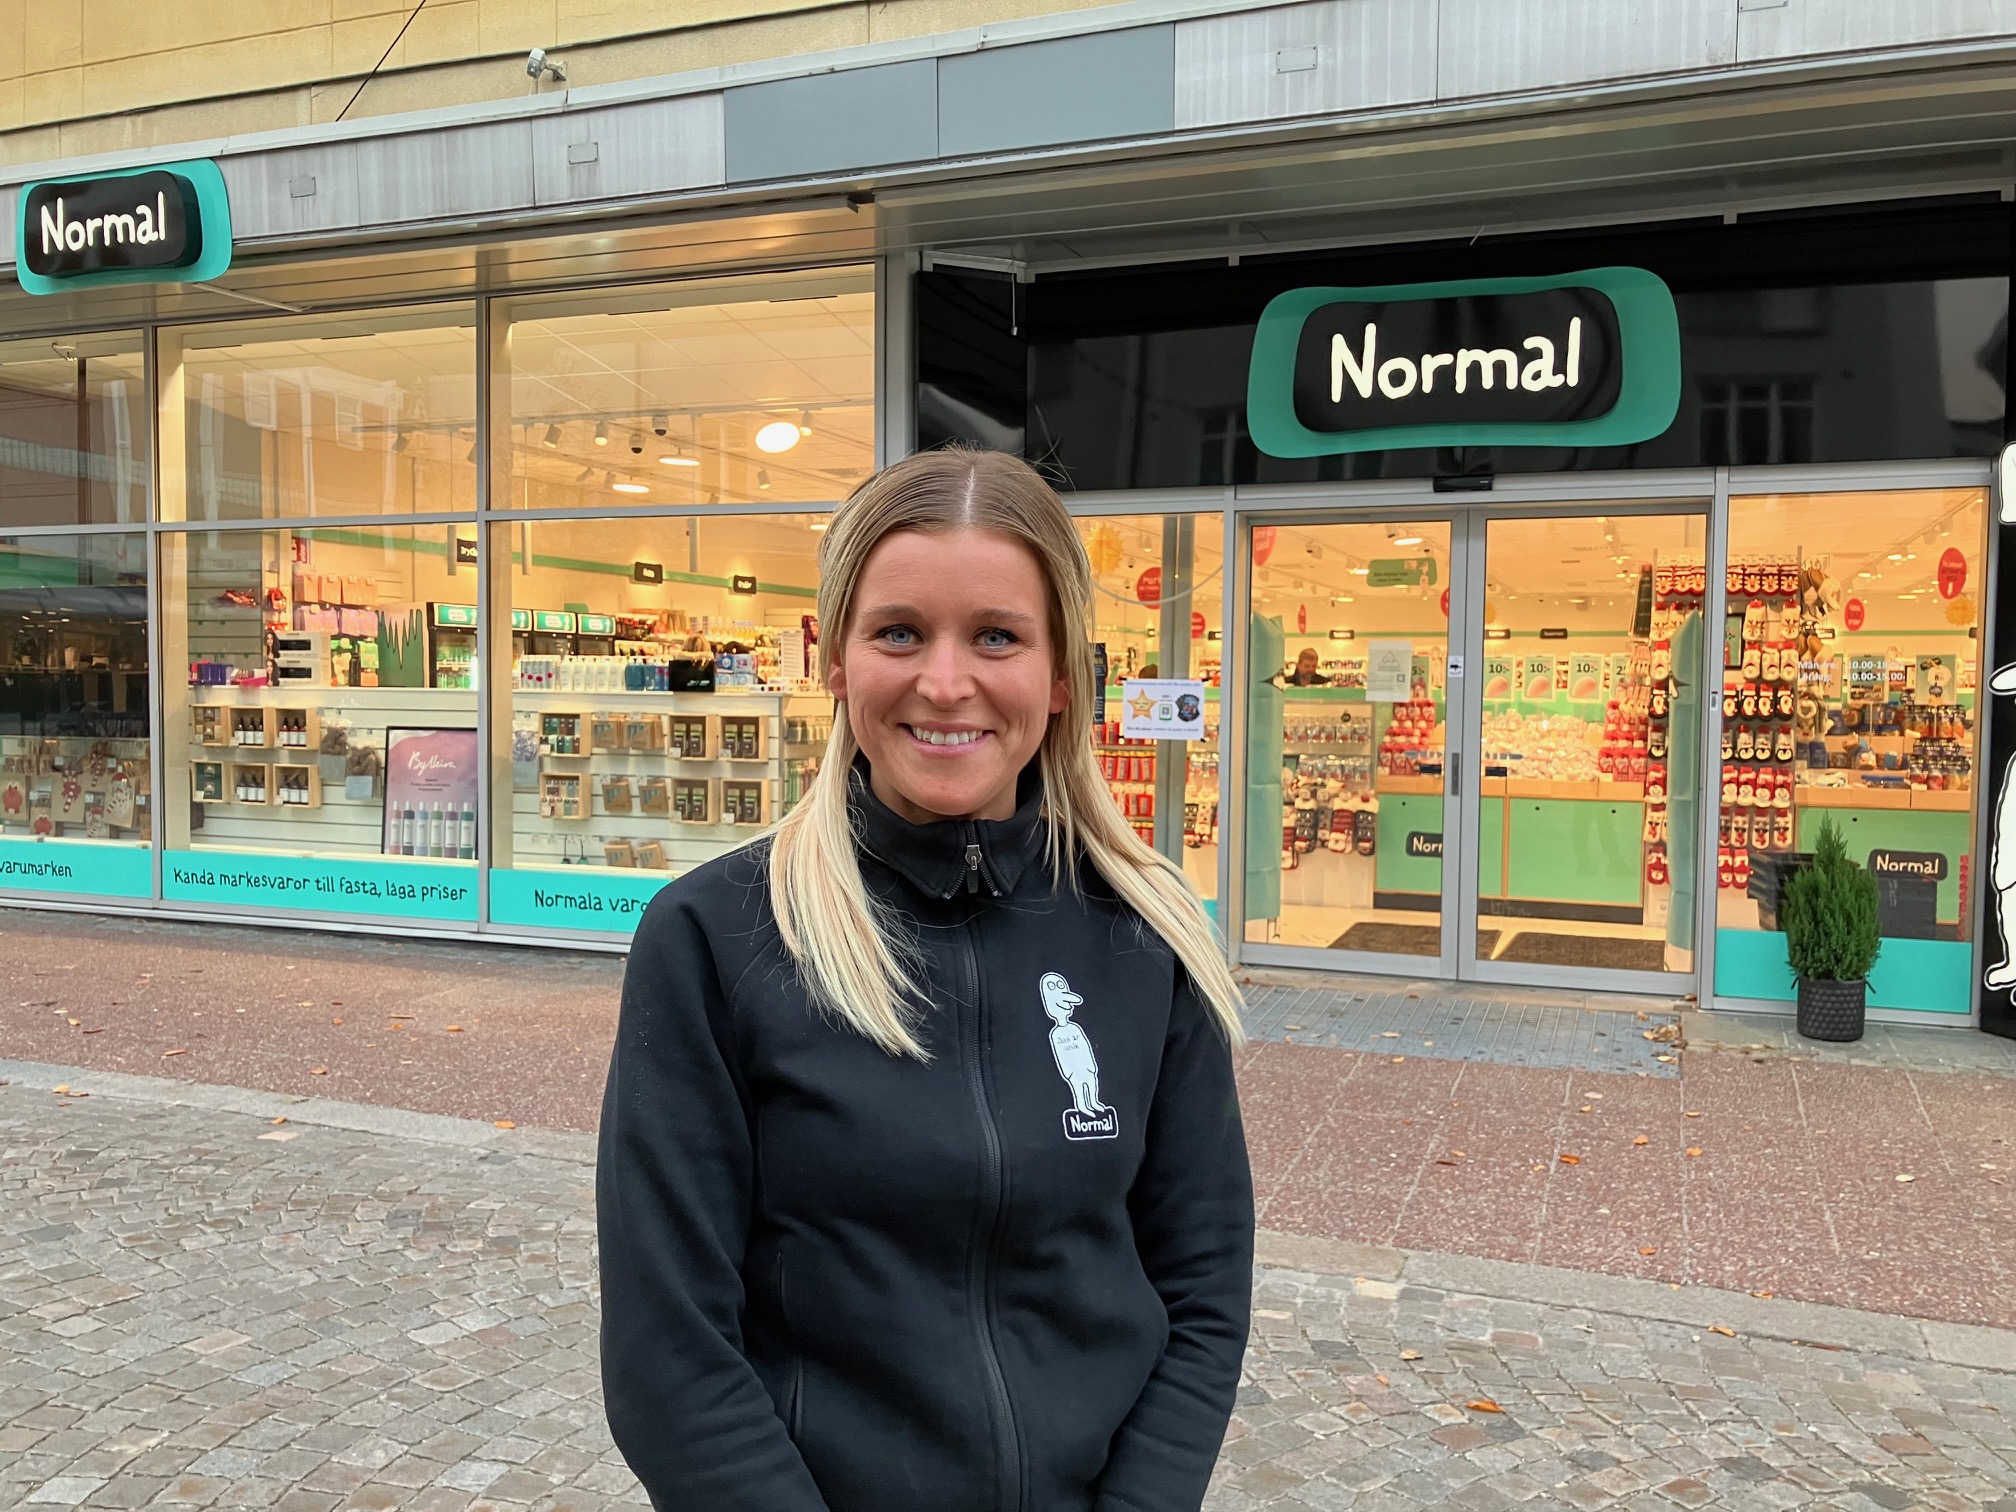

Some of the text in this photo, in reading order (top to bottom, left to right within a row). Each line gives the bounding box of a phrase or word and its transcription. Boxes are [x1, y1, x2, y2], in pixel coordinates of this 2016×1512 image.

[40, 190, 166, 255] Normal
[1331, 316, 1582, 403] Normal
[1876, 853, 1939, 874] Normal
[173, 867, 468, 902] Kända märkesvaror till fasta, låga priser
[534, 889, 604, 911] Normala
[1069, 1114, 1114, 1133] Normal
